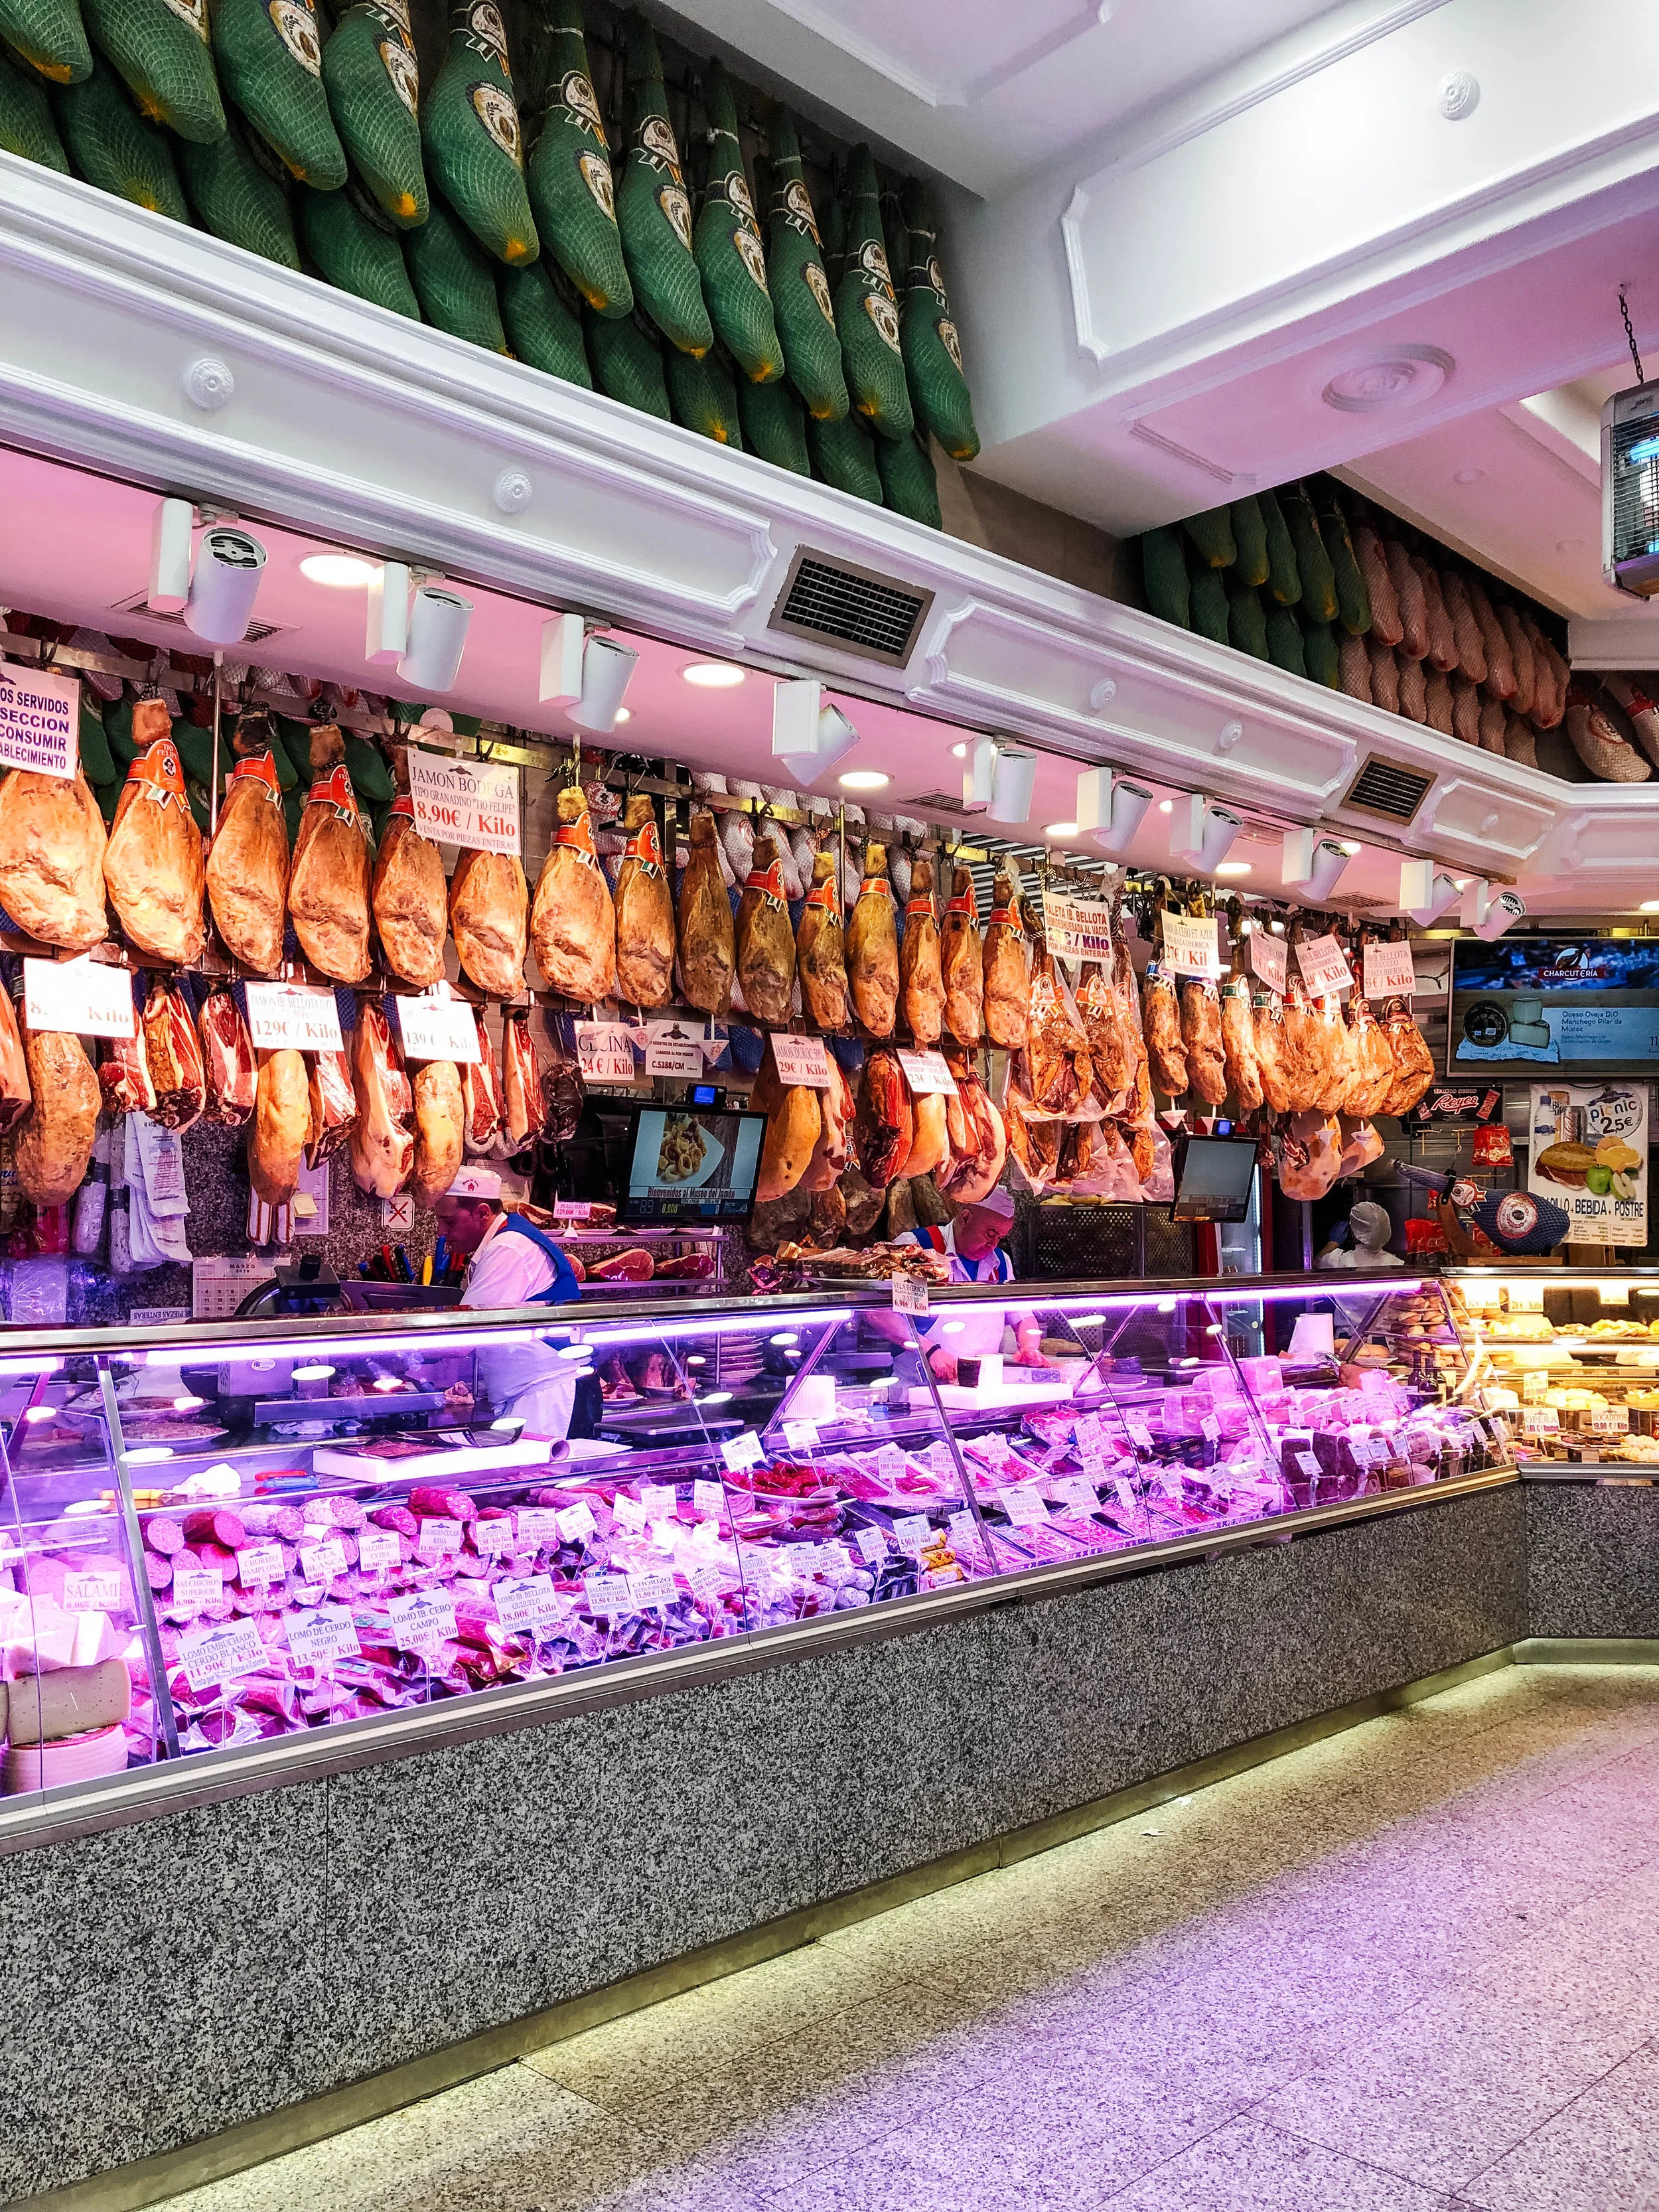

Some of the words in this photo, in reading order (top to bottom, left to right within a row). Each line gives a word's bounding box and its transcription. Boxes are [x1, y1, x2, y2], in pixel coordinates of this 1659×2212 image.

[17, 691, 68, 715] SERVIDOS
[0, 707, 69, 733] SECCION
[0, 724, 66, 751] CONSUMIR
[412, 767, 455, 789] JAMON
[459, 777, 514, 799] BODEGA
[413, 785, 429, 798] TIPO
[430, 790, 471, 807] GRANADINO
[489, 802, 516, 814] FELIPE"
[417, 801, 461, 828] 8,90€
[478, 814, 516, 837] Kilo
[418, 824, 441, 837] VENTA
[441, 831, 455, 840] POR
[457, 833, 480, 846] PIEZAS
[482, 838, 515, 850] ENTERAS
[1045, 903, 1066, 919] PALETA
[1076, 911, 1107, 924] BELLOTA
[1085, 924, 1091, 934] AL
[1092, 926, 1108, 936] VACIO
[1200, 929, 1214, 940] AZUL
[1048, 941, 1058, 950] POR
[1080, 948, 1110, 958] ENTERAS
[1082, 934, 1110, 950] Kilo
[1189, 950, 1212, 966] Kil
[1313, 945, 1337, 960] BELLOTA
[1380, 950, 1408, 960] BELLOTA
[1268, 967, 1284, 984] Kilo
[1323, 966, 1347, 982] Kilo
[1386, 974, 1412, 986] Kilo
[88, 1006, 129, 1023] Kilo
[305, 1023, 338, 1039] Kilo
[775, 1045, 794, 1058] JAMON
[794, 1047, 814, 1060] DUROC
[581, 1058, 594, 1073] 24
[597, 1058, 604, 1074] €
[614, 1059, 633, 1074] Kilo
[652, 1060, 684, 1070] C.5288/CM
[779, 1061, 796, 1073] 29€
[806, 1063, 828, 1075] Kilo
[934, 1075, 954, 1086] Kilo
[1430, 1094, 1479, 1115] Reyes
[1590, 1100, 1638, 1122] picnic
[1601, 1116, 1633, 1134] 2,5€
[648, 1187, 682, 1197] Bienvenidos
[683, 1187, 688, 1197] al
[689, 1189, 707, 1198] Museo
[708, 1189, 718, 1198] del
[718, 1189, 735, 1199] Jamón
[662, 1203, 678, 1215] 0,000
[1575, 1199, 1607, 1215] BEBIDA
[1615, 1201, 1644, 1217] POSTRE
[894, 1282, 906, 1290] VELA
[906, 1285, 925, 1293] IBERICA
[895, 1299, 909, 1308] 6,90€
[914, 1301, 926, 1311] Kilo
[360, 1542, 398, 1552] SALCHICHON
[244, 1555, 277, 1567] CHORIZO
[311, 1550, 336, 1562] VELA
[242, 1563, 283, 1577] PAMPLONA
[306, 1556, 344, 1573] BLANCA
[332, 1565, 346, 1574] Kilo
[67, 1583, 117, 1597] SALAMI
[175, 1579, 220, 1587] SALCHICHON
[588, 1584, 624, 1593] SALCHICHON
[632, 1577, 671, 1587] CHORIZO
[498, 1595, 515, 1604] LOMO
[524, 1587, 551, 1598] BELLOTA
[393, 1611, 416, 1624] LOMO
[417, 1609, 428, 1618] IB.
[429, 1603, 451, 1615] CEBO
[502, 1608, 530, 1622] 38,00€
[538, 1603, 556, 1614] Kilo
[289, 1629, 312, 1641] LOMO
[313, 1627, 325, 1636] DE
[325, 1621, 351, 1633] CERDO
[410, 1617, 439, 1631] CAMPO
[311, 1635, 337, 1647] NEGRO
[399, 1631, 431, 1647] 25,00€
[437, 1625, 457, 1637] Kilo
[182, 1648, 206, 1660] LOMO
[207, 1631, 255, 1653] EMBUCHADO
[297, 1649, 328, 1664] 13,50€
[338, 1643, 359, 1655] Kilo
[188, 1653, 218, 1668] CERDO
[220, 1640, 255, 1659] BLANCO
[189, 1659, 227, 1678] 11,90€
[238, 1649, 262, 1662] Kilo
